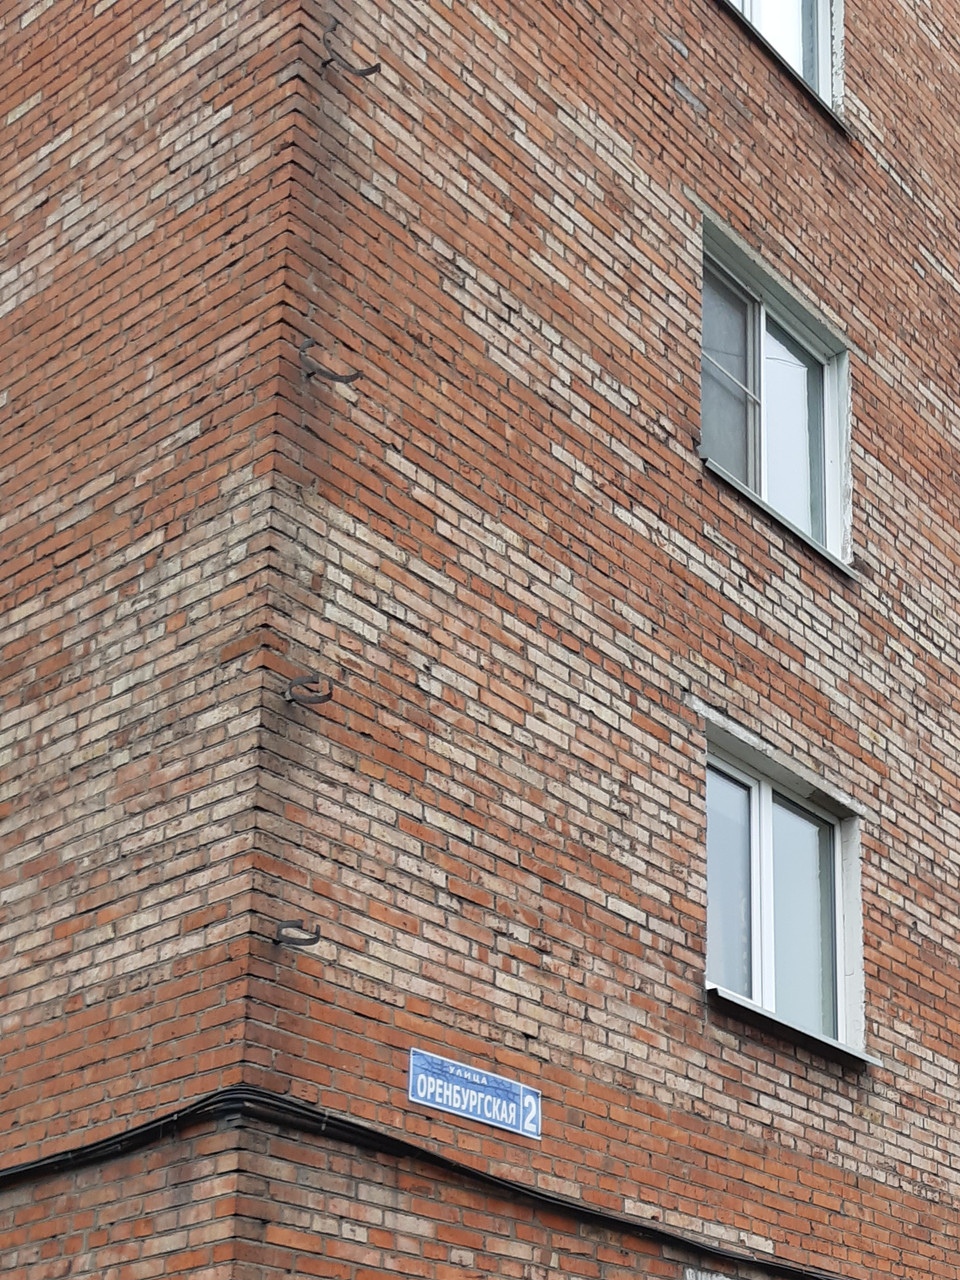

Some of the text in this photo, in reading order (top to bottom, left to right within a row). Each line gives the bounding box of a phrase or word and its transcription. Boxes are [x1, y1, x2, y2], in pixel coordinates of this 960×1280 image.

[448, 1066, 488, 1085] УЛИЦА
[416, 1074, 516, 1126] ОРЕНБУРГСКАЯ
[523, 1094, 537, 1132] 2
